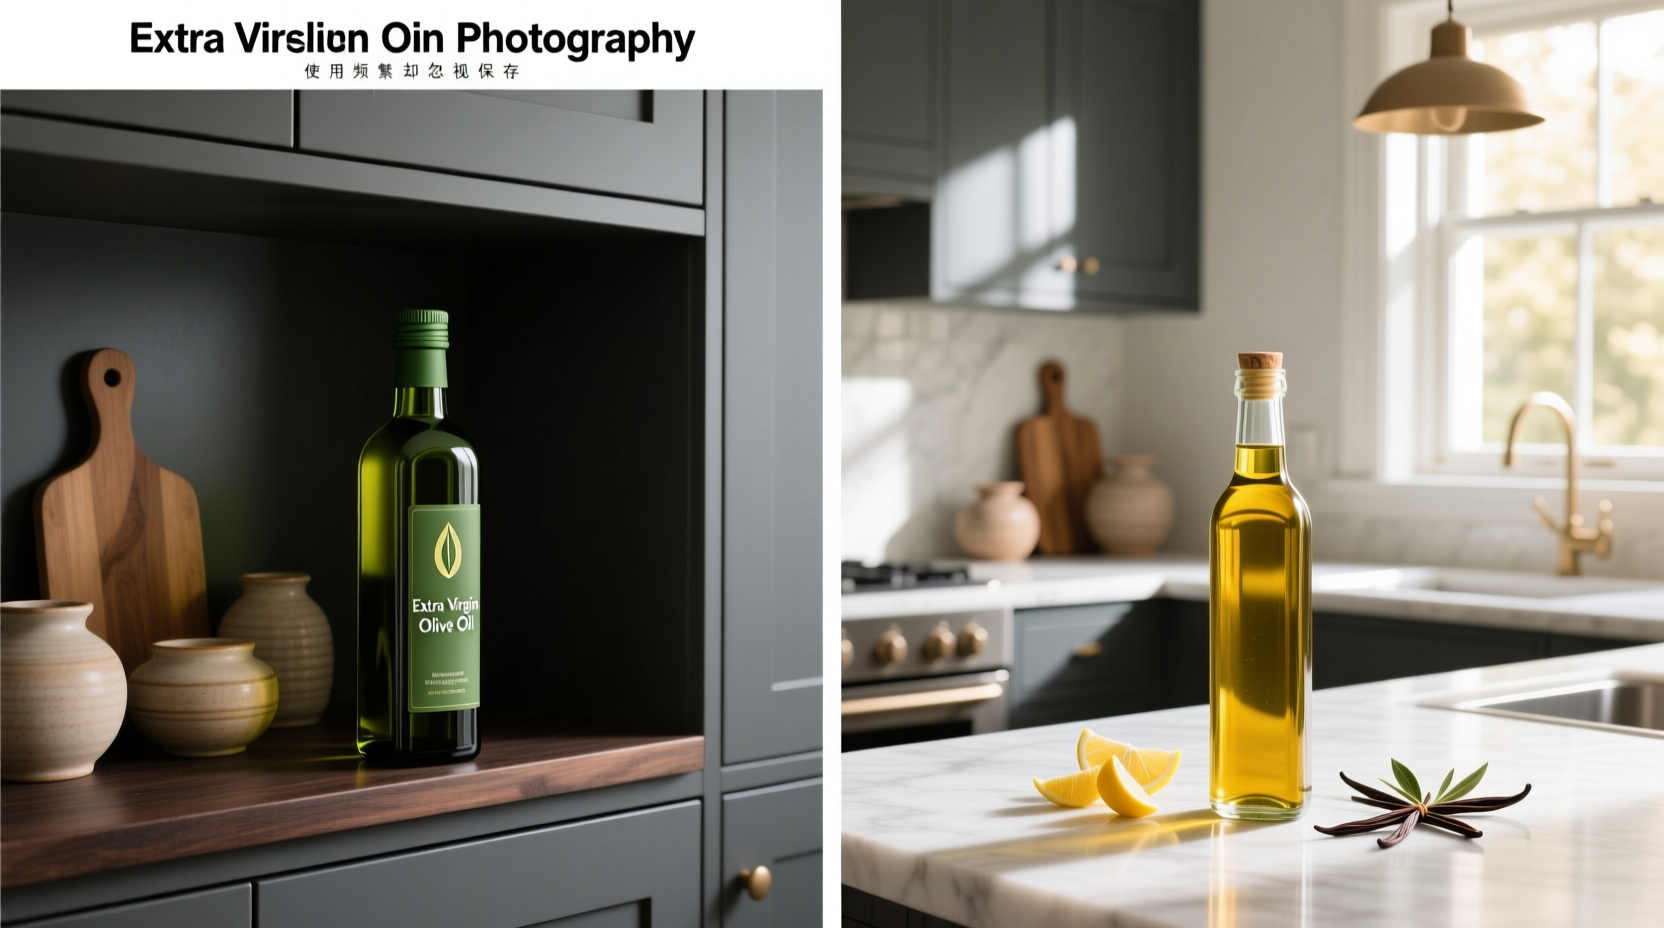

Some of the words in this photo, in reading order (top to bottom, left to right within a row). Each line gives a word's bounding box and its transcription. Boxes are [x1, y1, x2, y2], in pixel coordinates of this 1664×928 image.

[412, 598, 444, 613] Extra
[447, 596, 479, 614] Virgin
[419, 617, 453, 633] Olive
